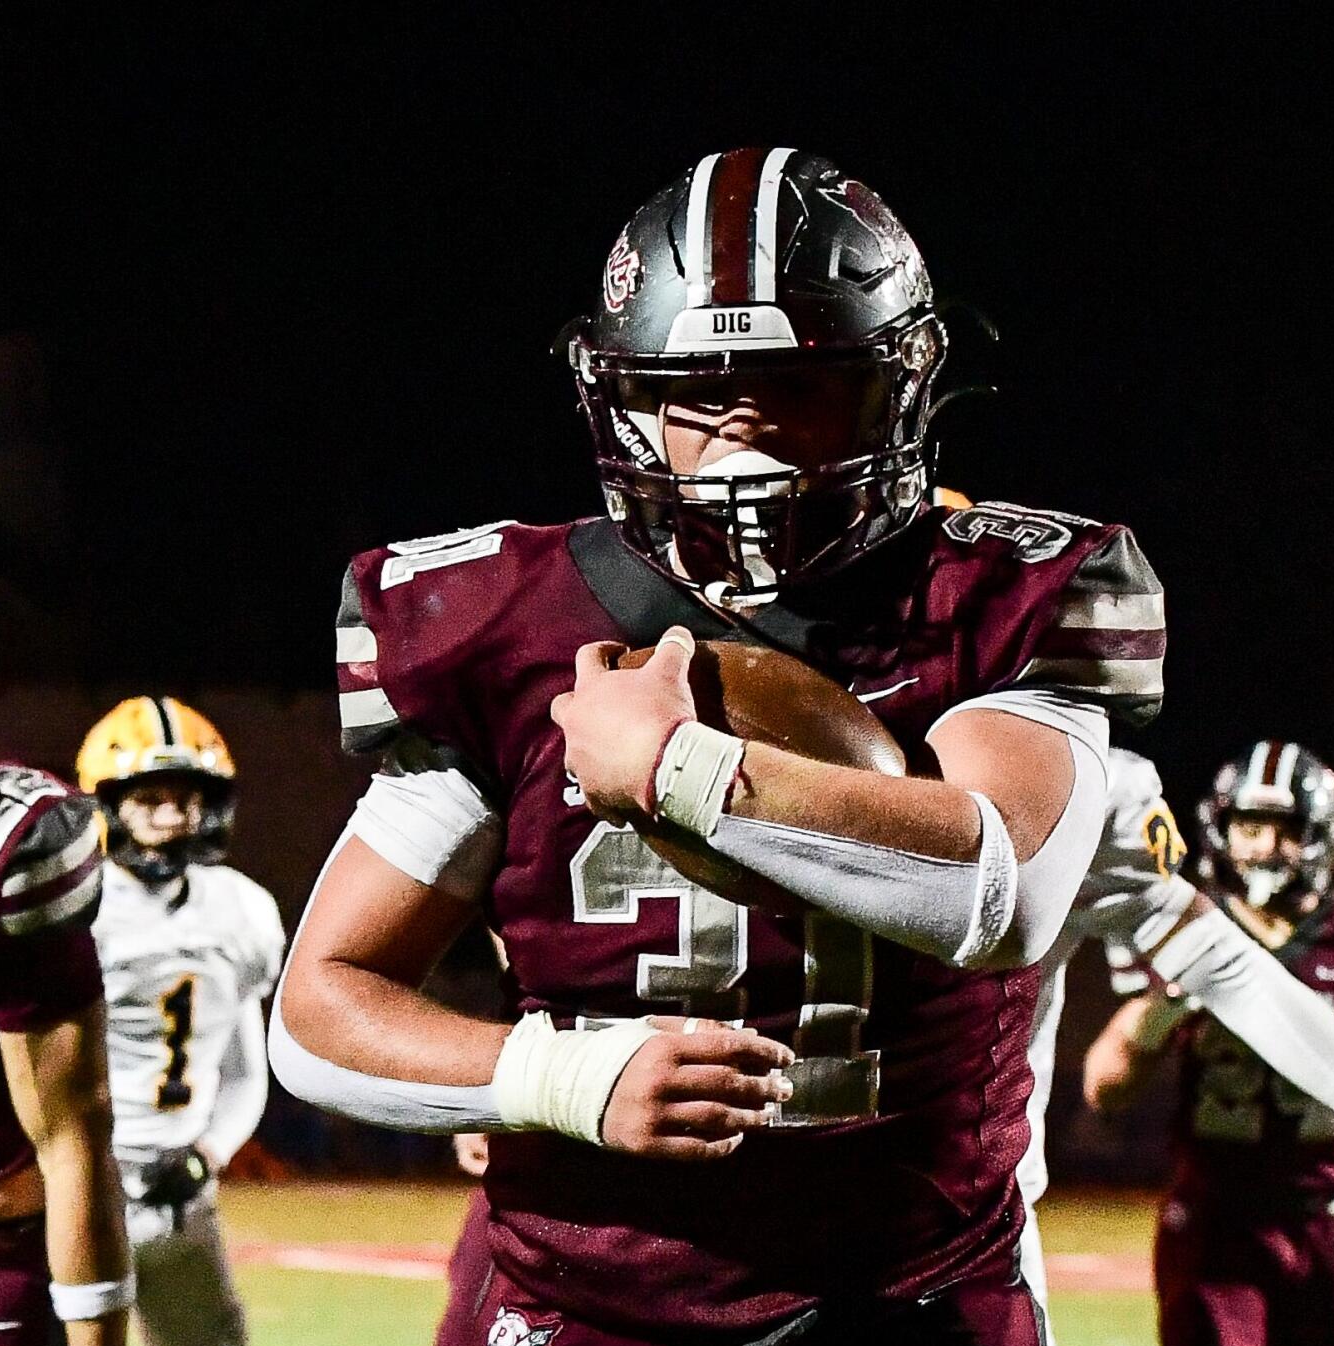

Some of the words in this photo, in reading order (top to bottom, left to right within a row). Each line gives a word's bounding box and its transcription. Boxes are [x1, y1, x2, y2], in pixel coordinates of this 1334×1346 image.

[712, 312, 752, 334] DIG
[609, 406, 658, 466] ddell
[154, 970, 195, 1112] 1
